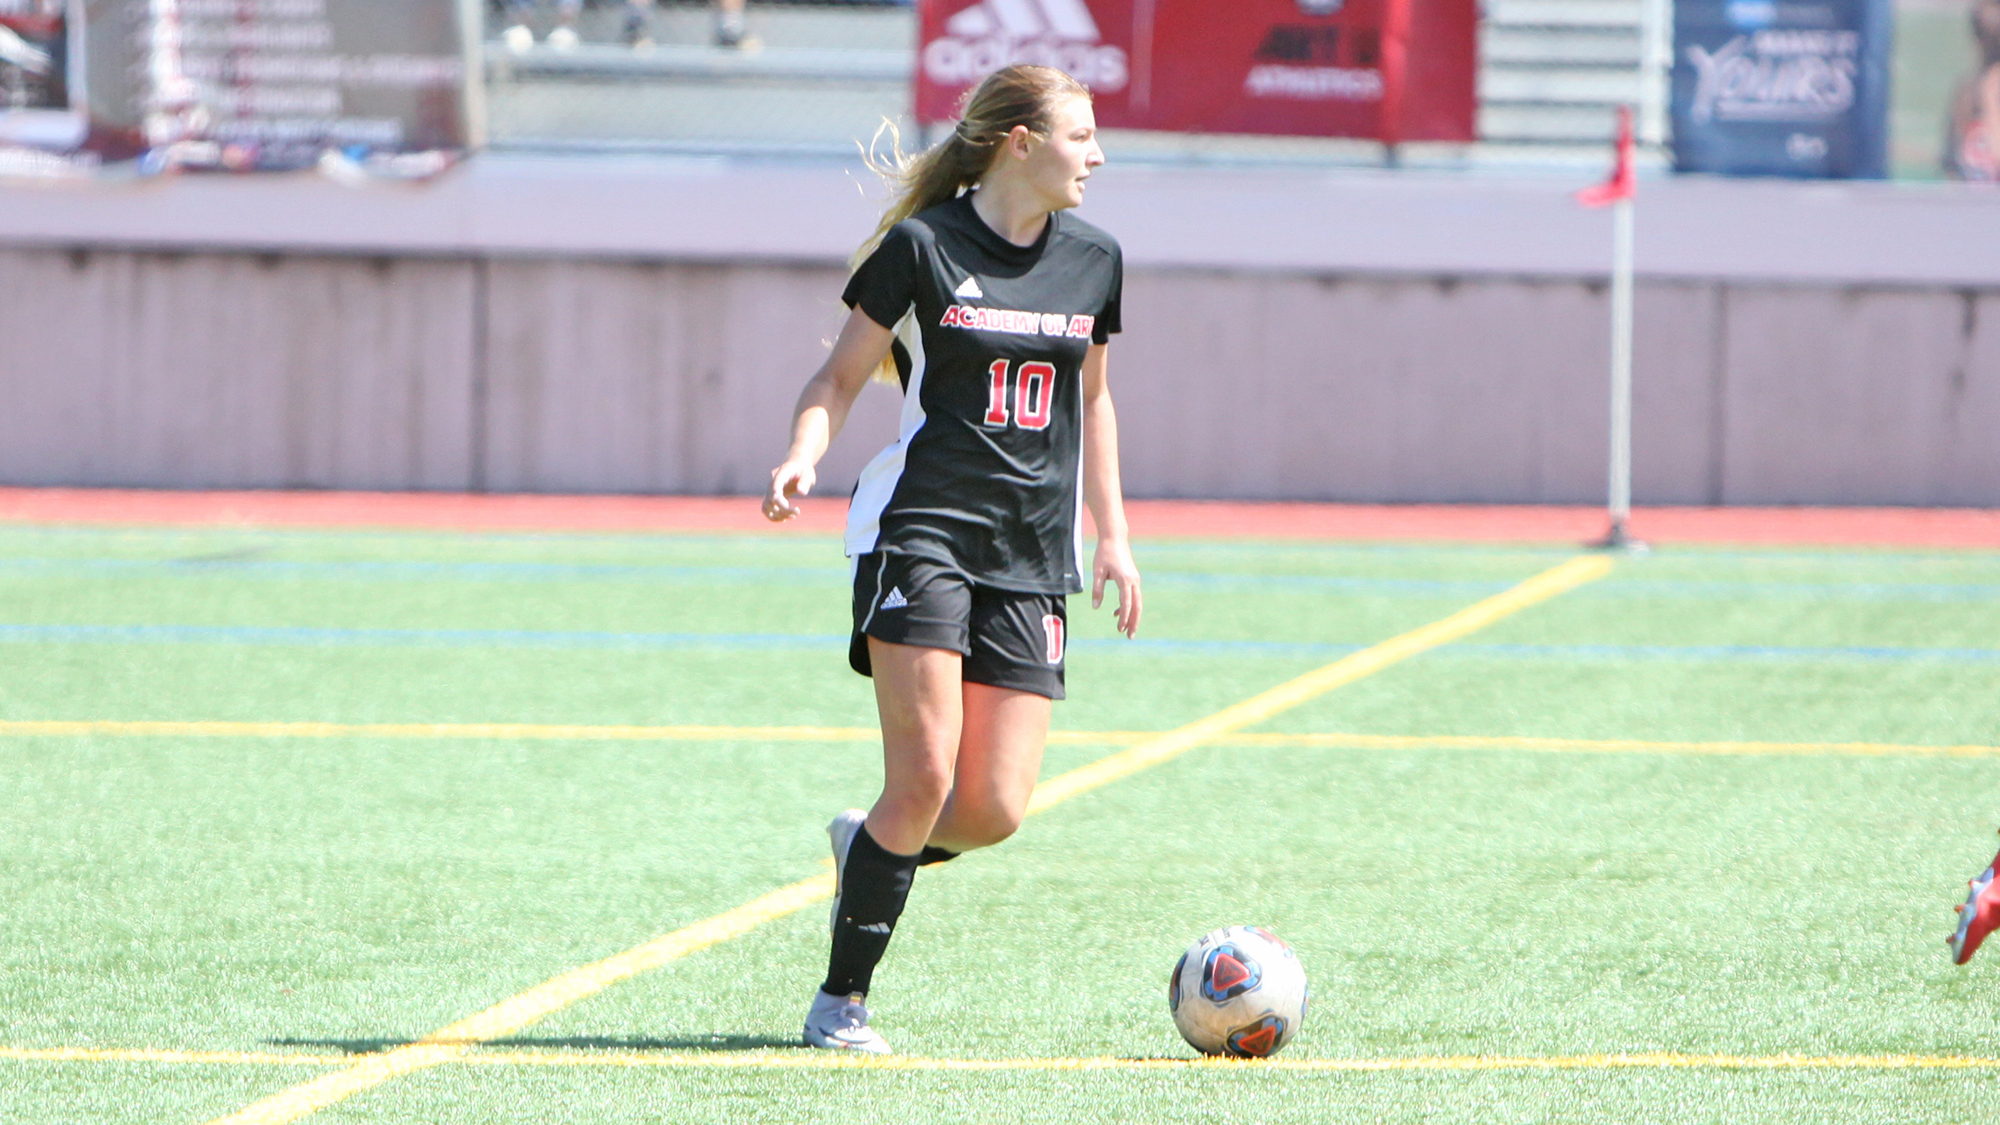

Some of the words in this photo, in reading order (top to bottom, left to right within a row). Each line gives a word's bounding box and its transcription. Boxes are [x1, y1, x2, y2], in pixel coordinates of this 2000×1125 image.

[924, 37, 1128, 93] adidas
[940, 305, 1041, 334] ACADEMY
[1041, 313, 1067, 337] OF
[984, 358, 1056, 432] 10
